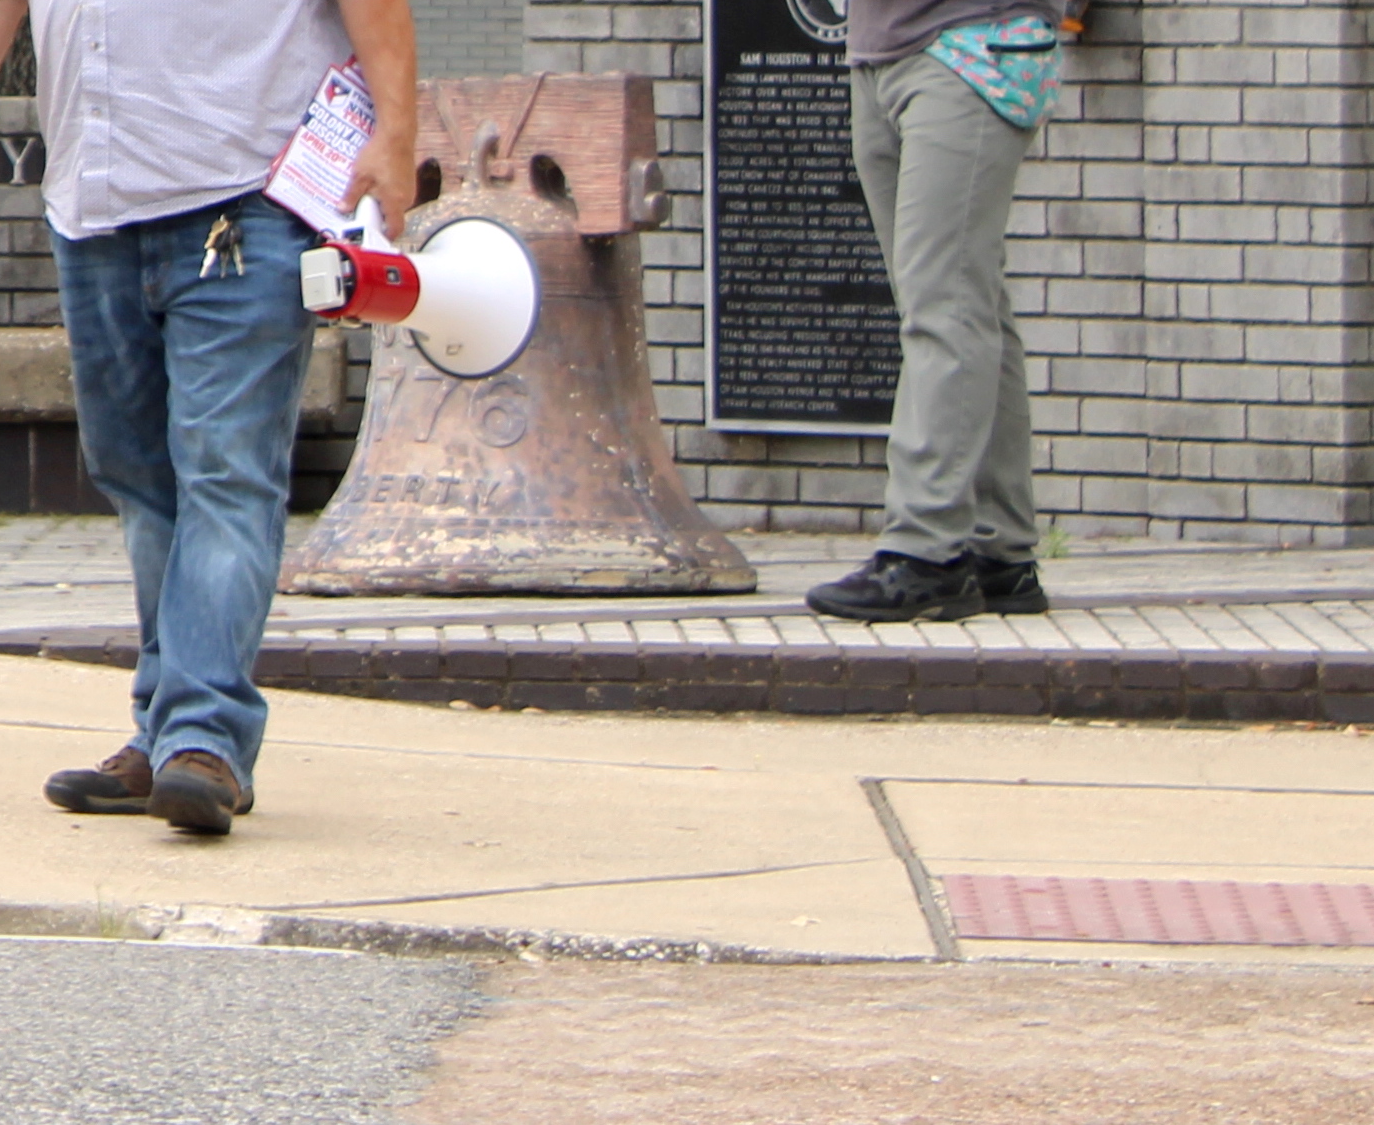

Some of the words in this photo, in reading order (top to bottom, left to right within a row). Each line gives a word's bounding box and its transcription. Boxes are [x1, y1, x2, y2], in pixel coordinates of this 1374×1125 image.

[739, 52, 762, 66] SAM
[765, 52, 811, 66] HOUSTON
[816, 52, 830, 66] IN
[307, 117, 358, 158] DISCUSS
[308, 100, 353, 139] COLONY
